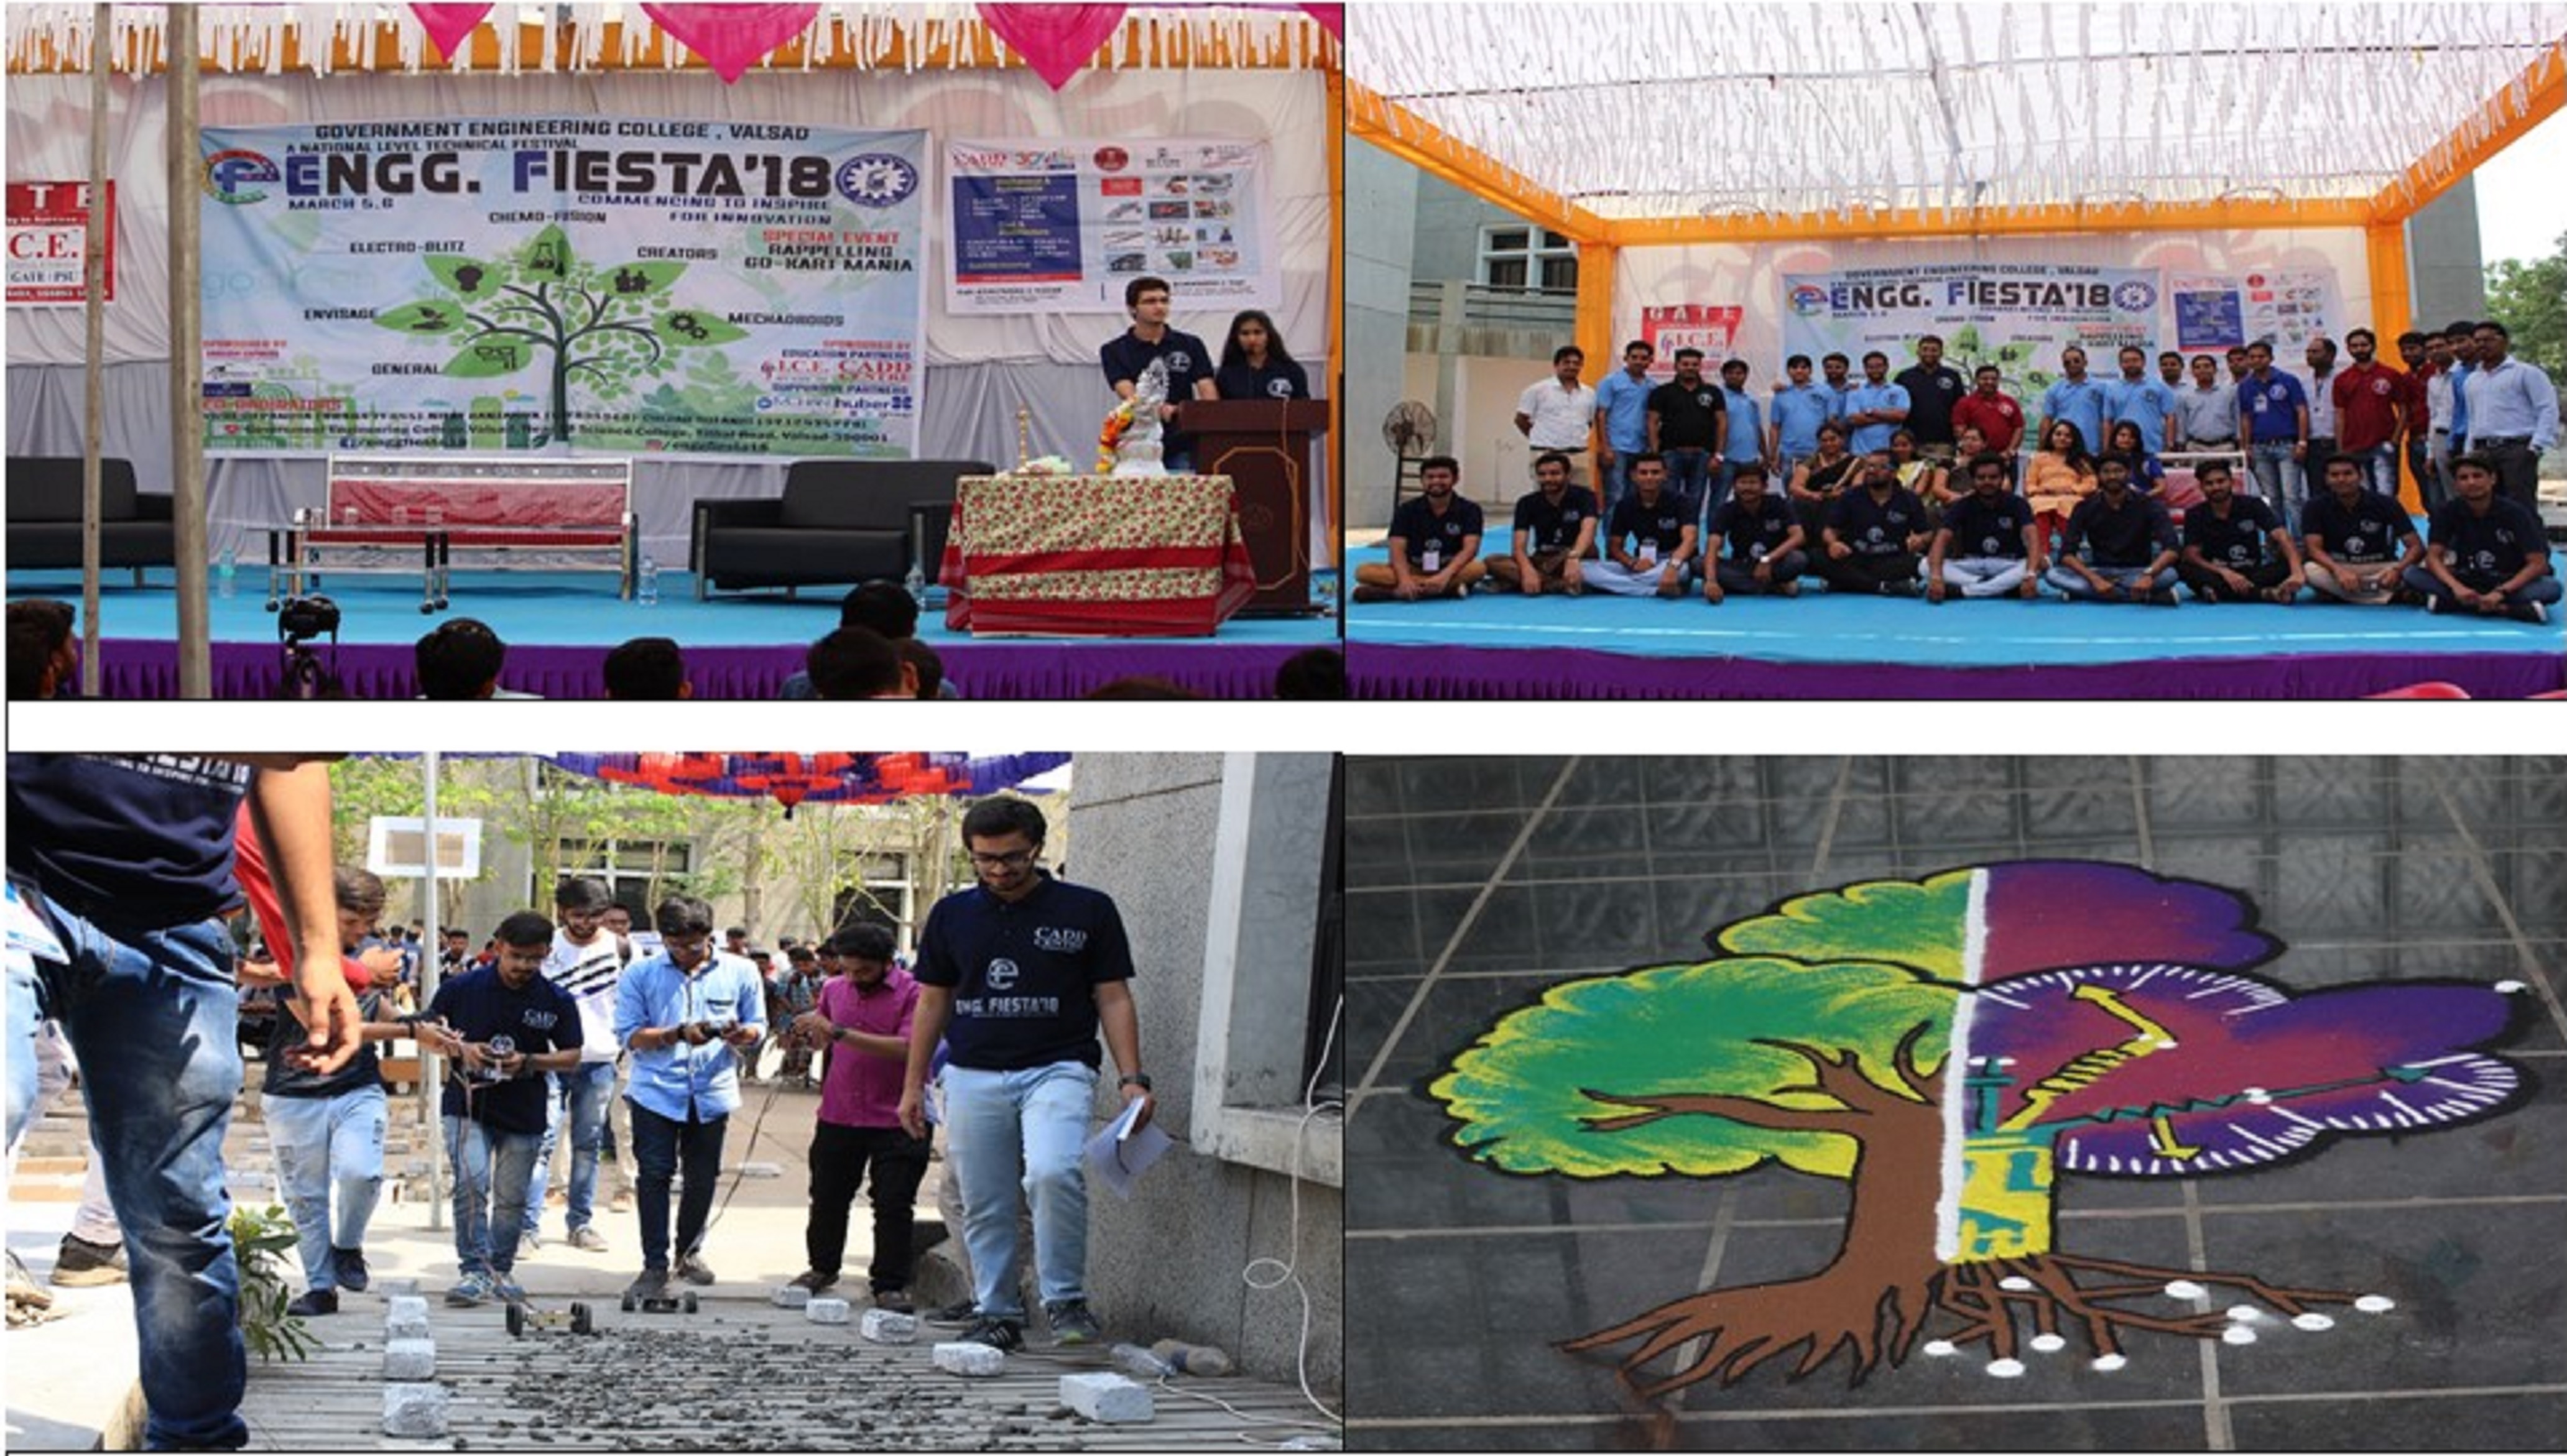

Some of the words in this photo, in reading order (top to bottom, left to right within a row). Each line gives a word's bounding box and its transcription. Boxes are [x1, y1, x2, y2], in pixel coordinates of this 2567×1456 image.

[316, 121, 460, 140] GOVERNMENT
[469, 120, 611, 137] ENGINEERING
[618, 121, 709, 138] COLLEGE
[730, 125, 810, 141] VALSAD
[286, 144, 295, 154] A
[300, 142, 372, 154] NATIONAL
[377, 141, 422, 152] LEVEL
[425, 139, 507, 152] TECHNICAL
[512, 139, 579, 150] FESTIVAL
[286, 152, 481, 196] ENGG.
[514, 150, 832, 198] FIESTA'18
[288, 198, 356, 210] MARCH
[579, 194, 715, 208] COMMENCING
[723, 196, 741, 208] TO
[753, 197, 832, 211] INSPIRE
[488, 210, 606, 224] CHEMO-FUSION
[669, 211, 707, 222] FOR
[713, 212, 832, 226] INNOVATION
[762, 229, 834, 243] SPECIAL
[843, 231, 900, 244] EVENT
[349, 240, 466, 254] ELECTRO-BLITZ
[637, 246, 718, 260] CREATORS
[769, 243, 893, 257] RAPPELLING
[744, 257, 836, 270] GO-KART
[844, 259, 913, 272] MANIA
[1830, 282, 1932, 311] ENGG.
[1947, 281, 2111, 307] FIESTA'18
[304, 307, 377, 321] ENVISAGE
[728, 312, 845, 327] MECHADROIDS
[782, 349, 848, 358] EDUCATION
[372, 362, 440, 375] GENERAL
[838, 360, 912, 372] CADD
